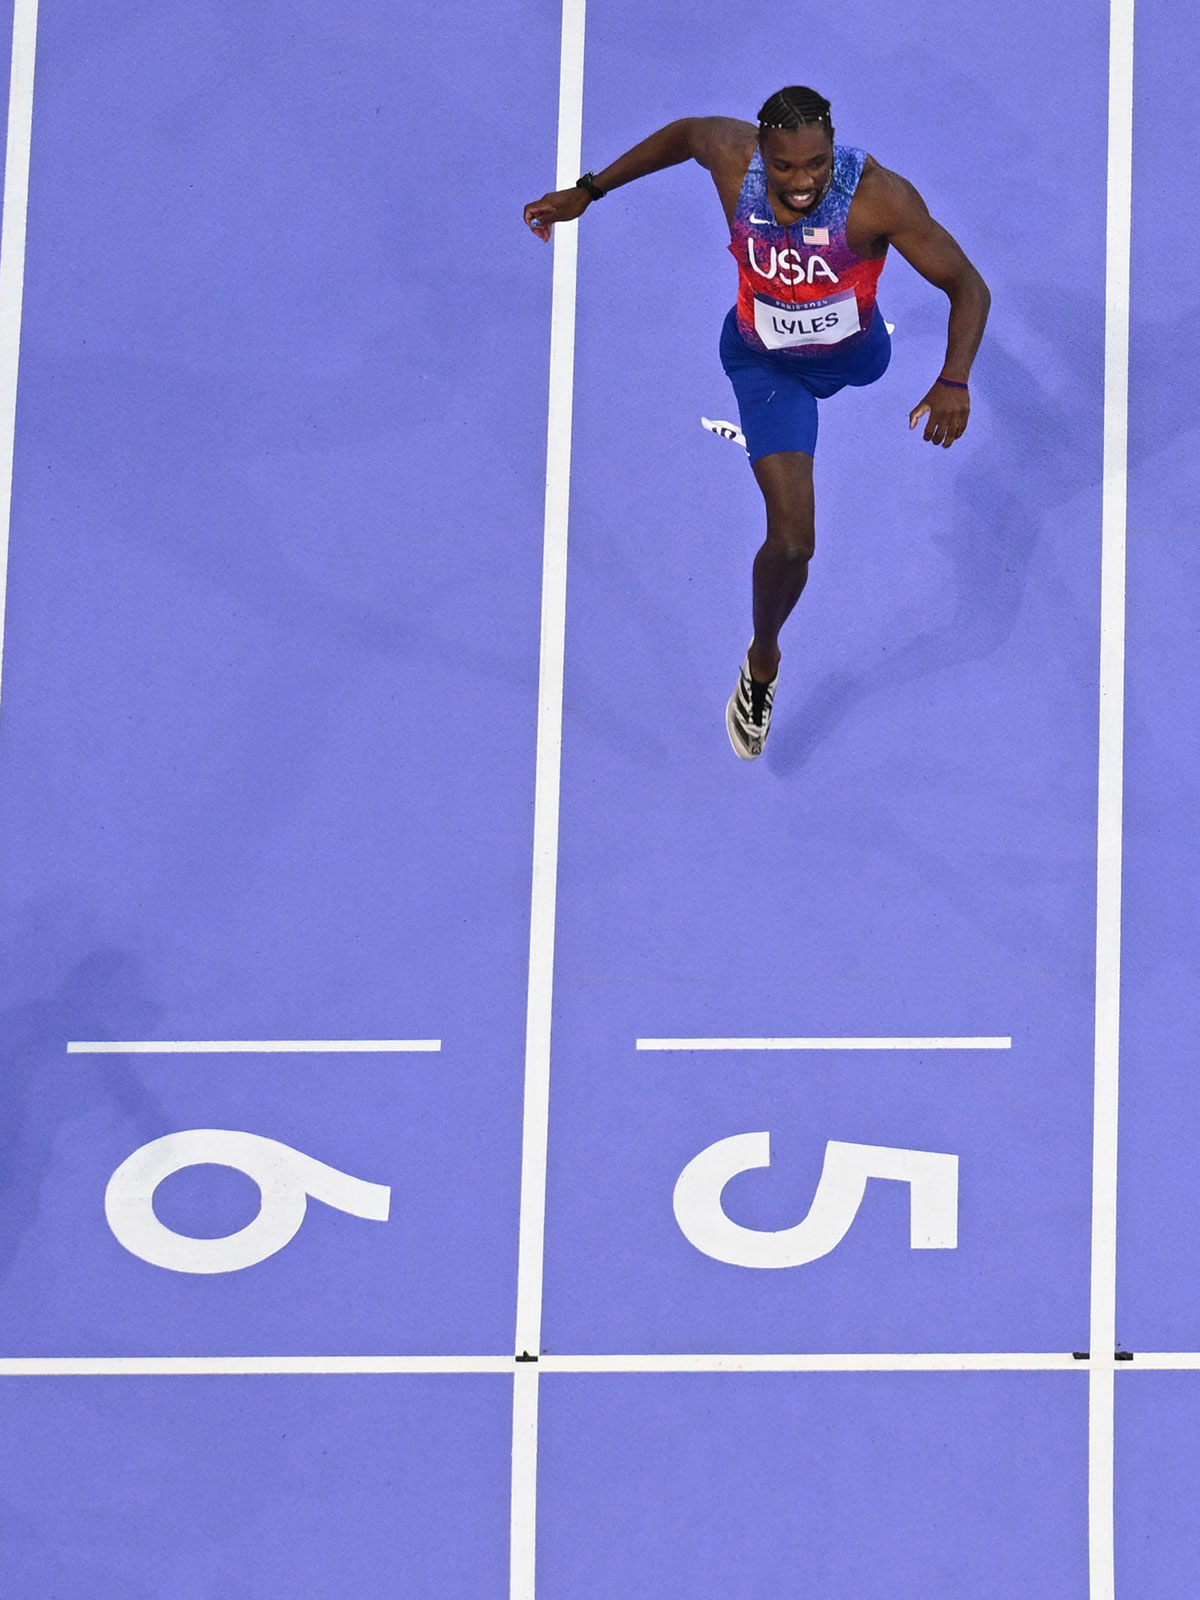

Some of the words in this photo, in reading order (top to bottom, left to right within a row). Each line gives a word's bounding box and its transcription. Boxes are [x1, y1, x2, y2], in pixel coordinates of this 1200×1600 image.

[748, 237, 839, 285] USA
[772, 312, 839, 335] LYLES
[775, 300, 801, 310] PARIS
[104, 1129, 391, 1274] 6
[673, 1131, 959, 1269] 5
